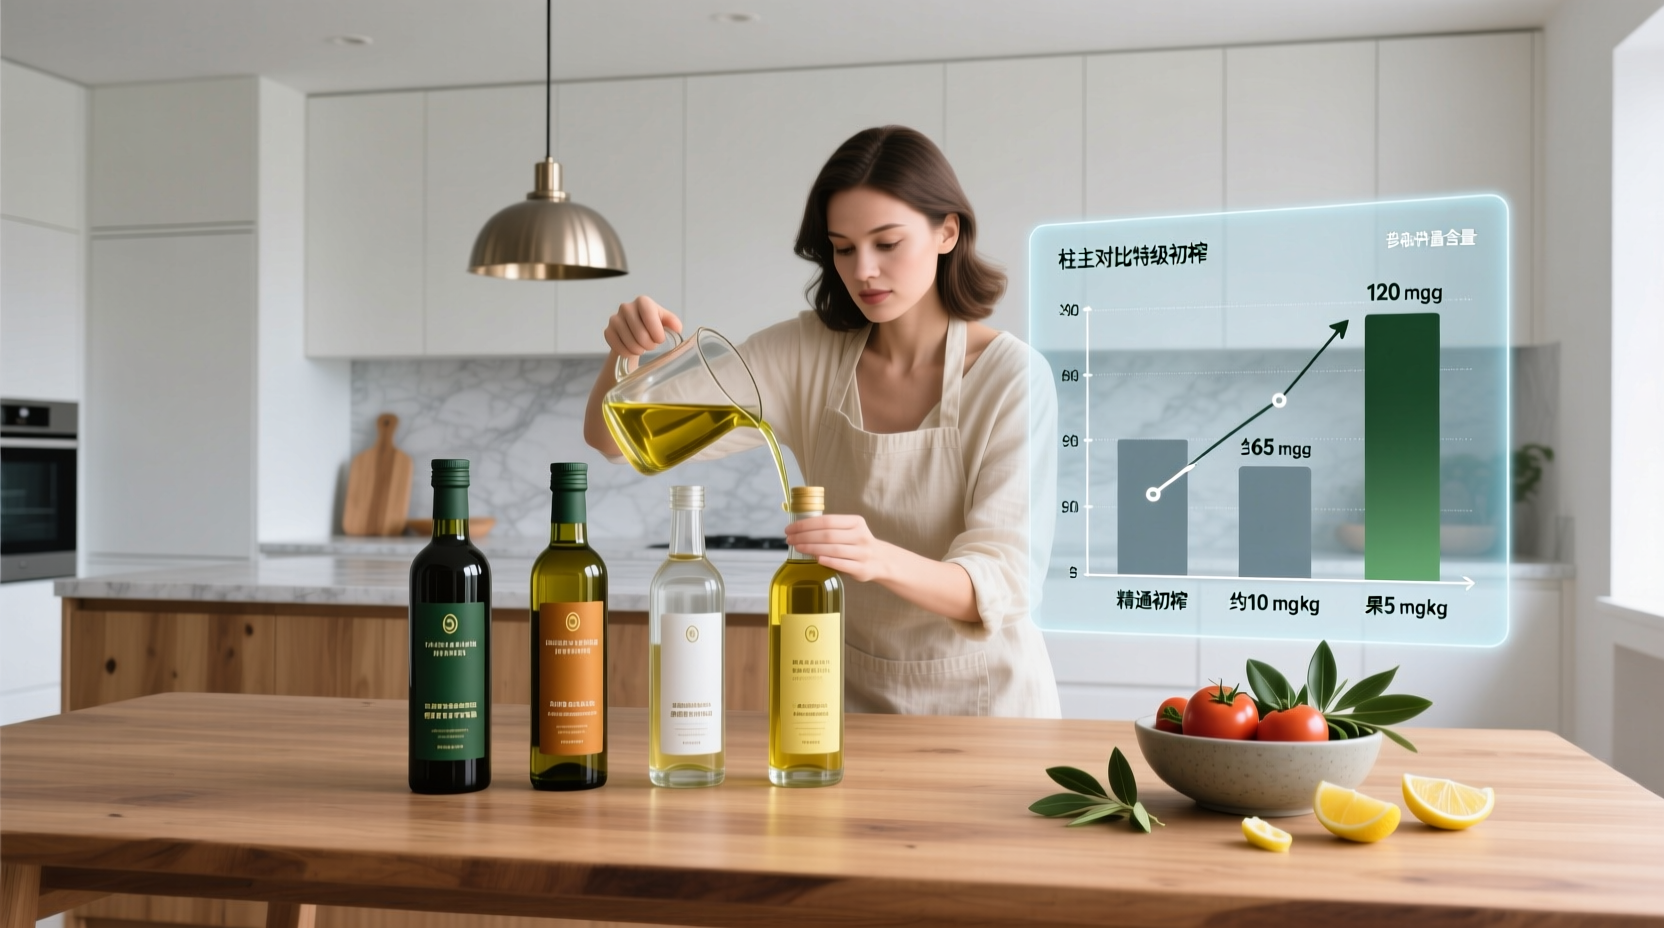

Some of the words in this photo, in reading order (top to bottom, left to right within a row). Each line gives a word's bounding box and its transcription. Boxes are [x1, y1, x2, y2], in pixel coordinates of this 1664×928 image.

[1367, 282, 1400, 301] 120
[1404, 287, 1442, 304] mgg
[1279, 445, 1311, 459] mgg
[1229, 591, 1268, 611] 约10
[1272, 596, 1320, 615] mgkg
[1399, 598, 1447, 619] mgkg
